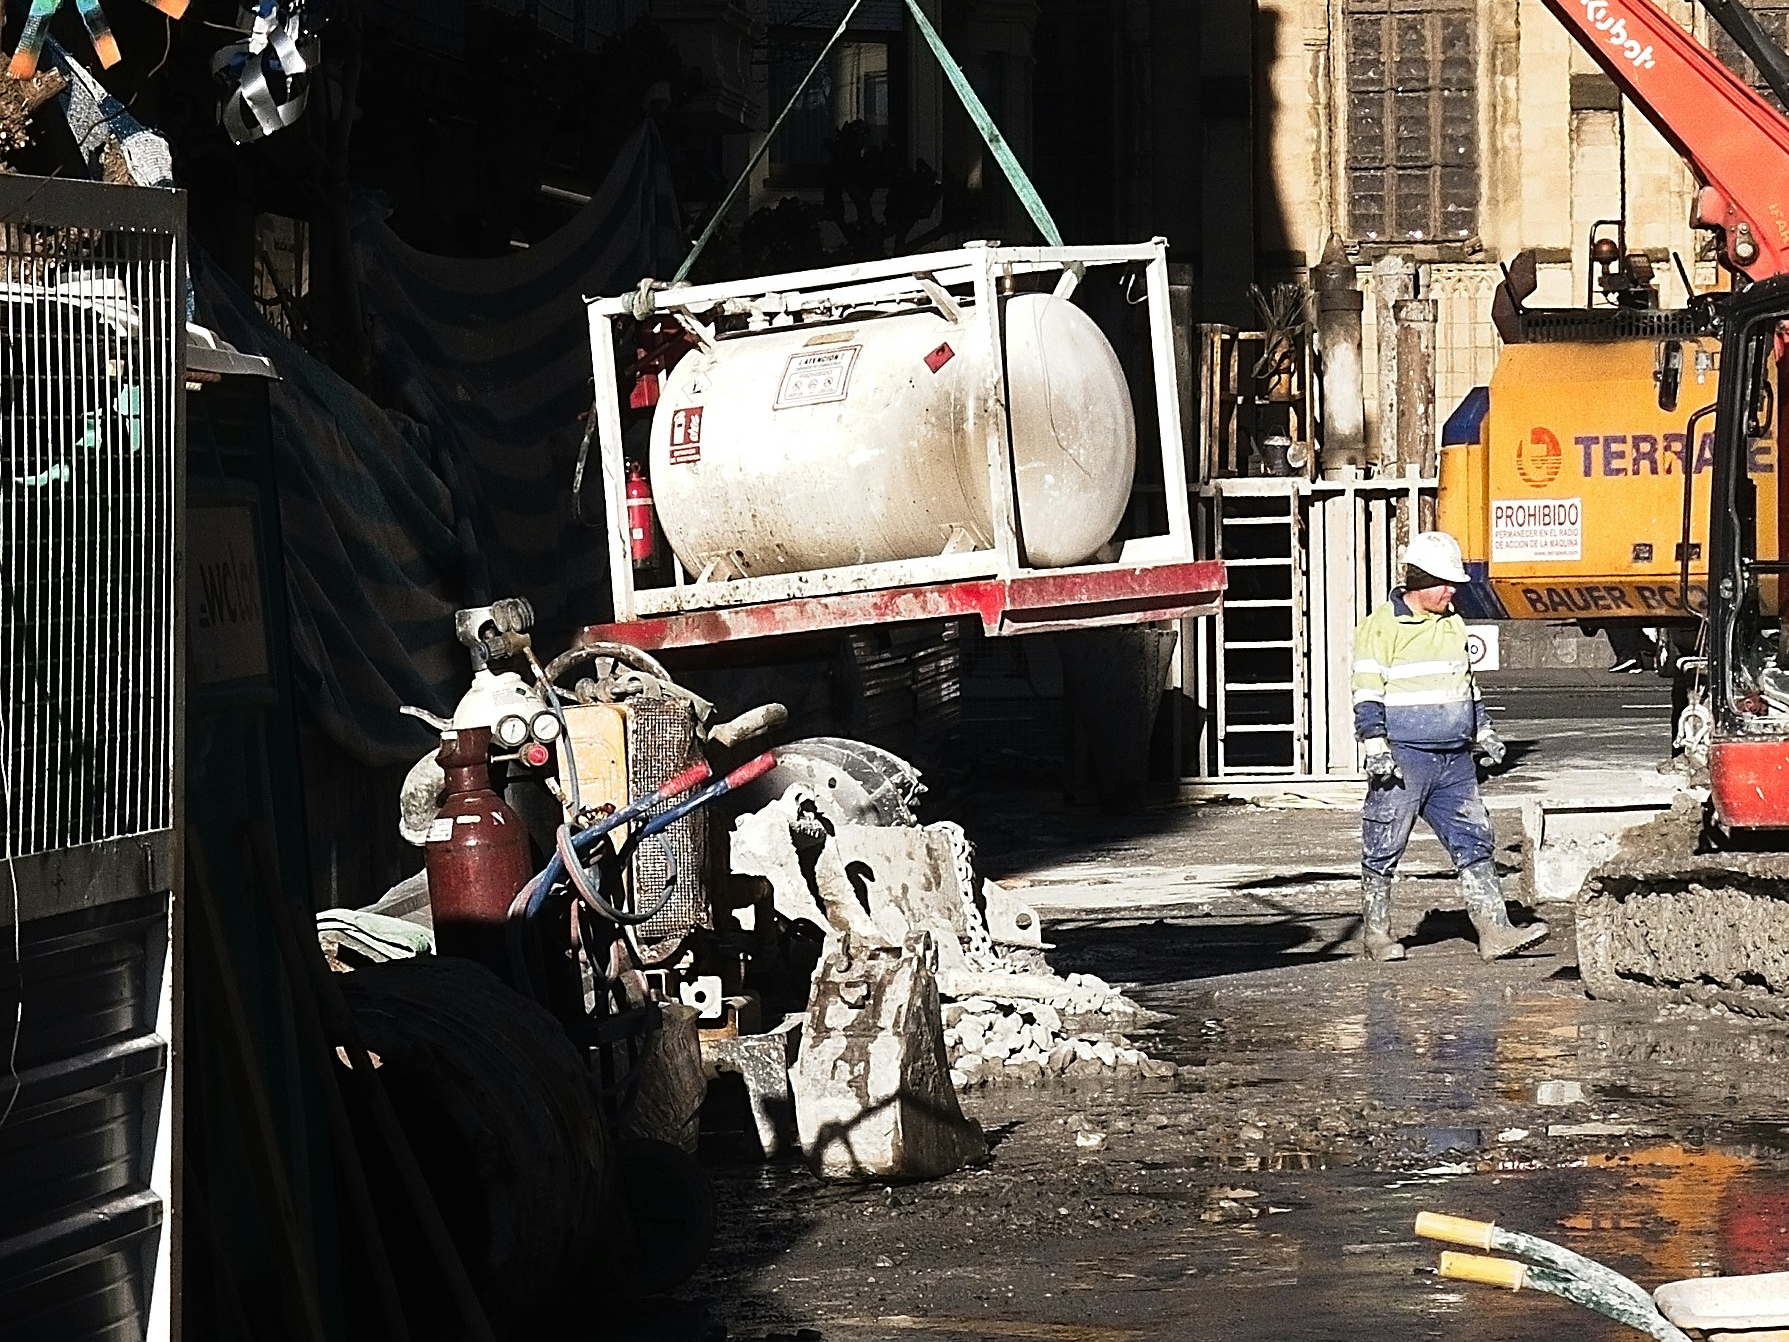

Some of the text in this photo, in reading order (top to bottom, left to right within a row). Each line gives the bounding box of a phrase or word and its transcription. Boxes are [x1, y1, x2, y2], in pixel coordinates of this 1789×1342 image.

[1495, 503, 1579, 528] PROHIBIDO
[1495, 528, 1578, 539] PERMANECER EN EL RADIO
[1495, 541, 1503, 550] DE
[1530, 540, 1538, 548] DE
[1540, 539, 1548, 548] LA
[1522, 585, 1633, 613] BAUER
